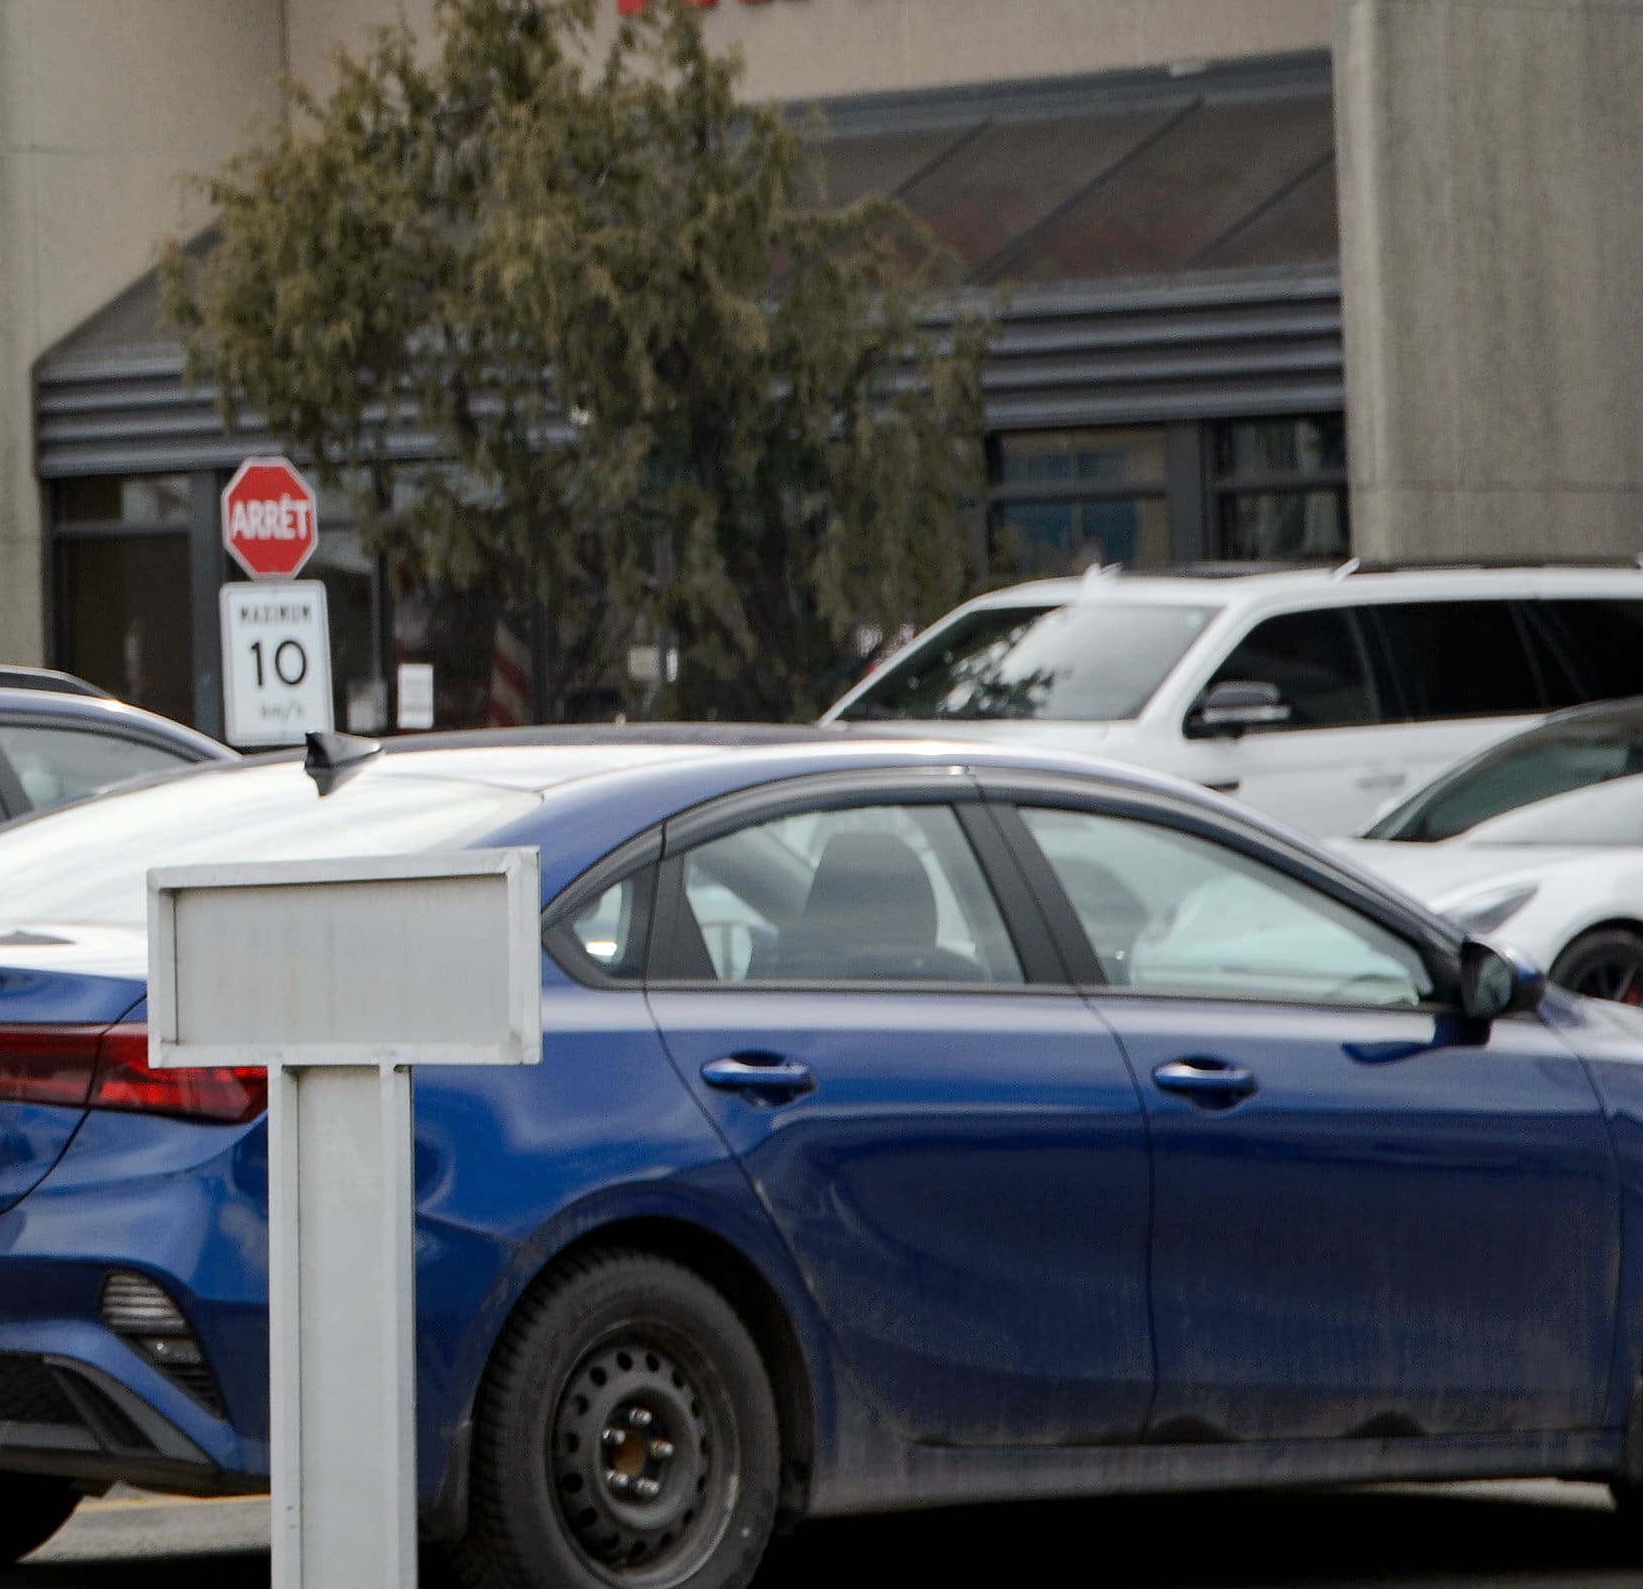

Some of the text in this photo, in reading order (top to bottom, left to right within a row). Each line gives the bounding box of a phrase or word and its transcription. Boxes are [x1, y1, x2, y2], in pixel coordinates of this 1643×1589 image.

[231, 493, 310, 540] ARRÊT
[239, 603, 312, 625] MAXIMUM
[250, 639, 308, 688] 10
